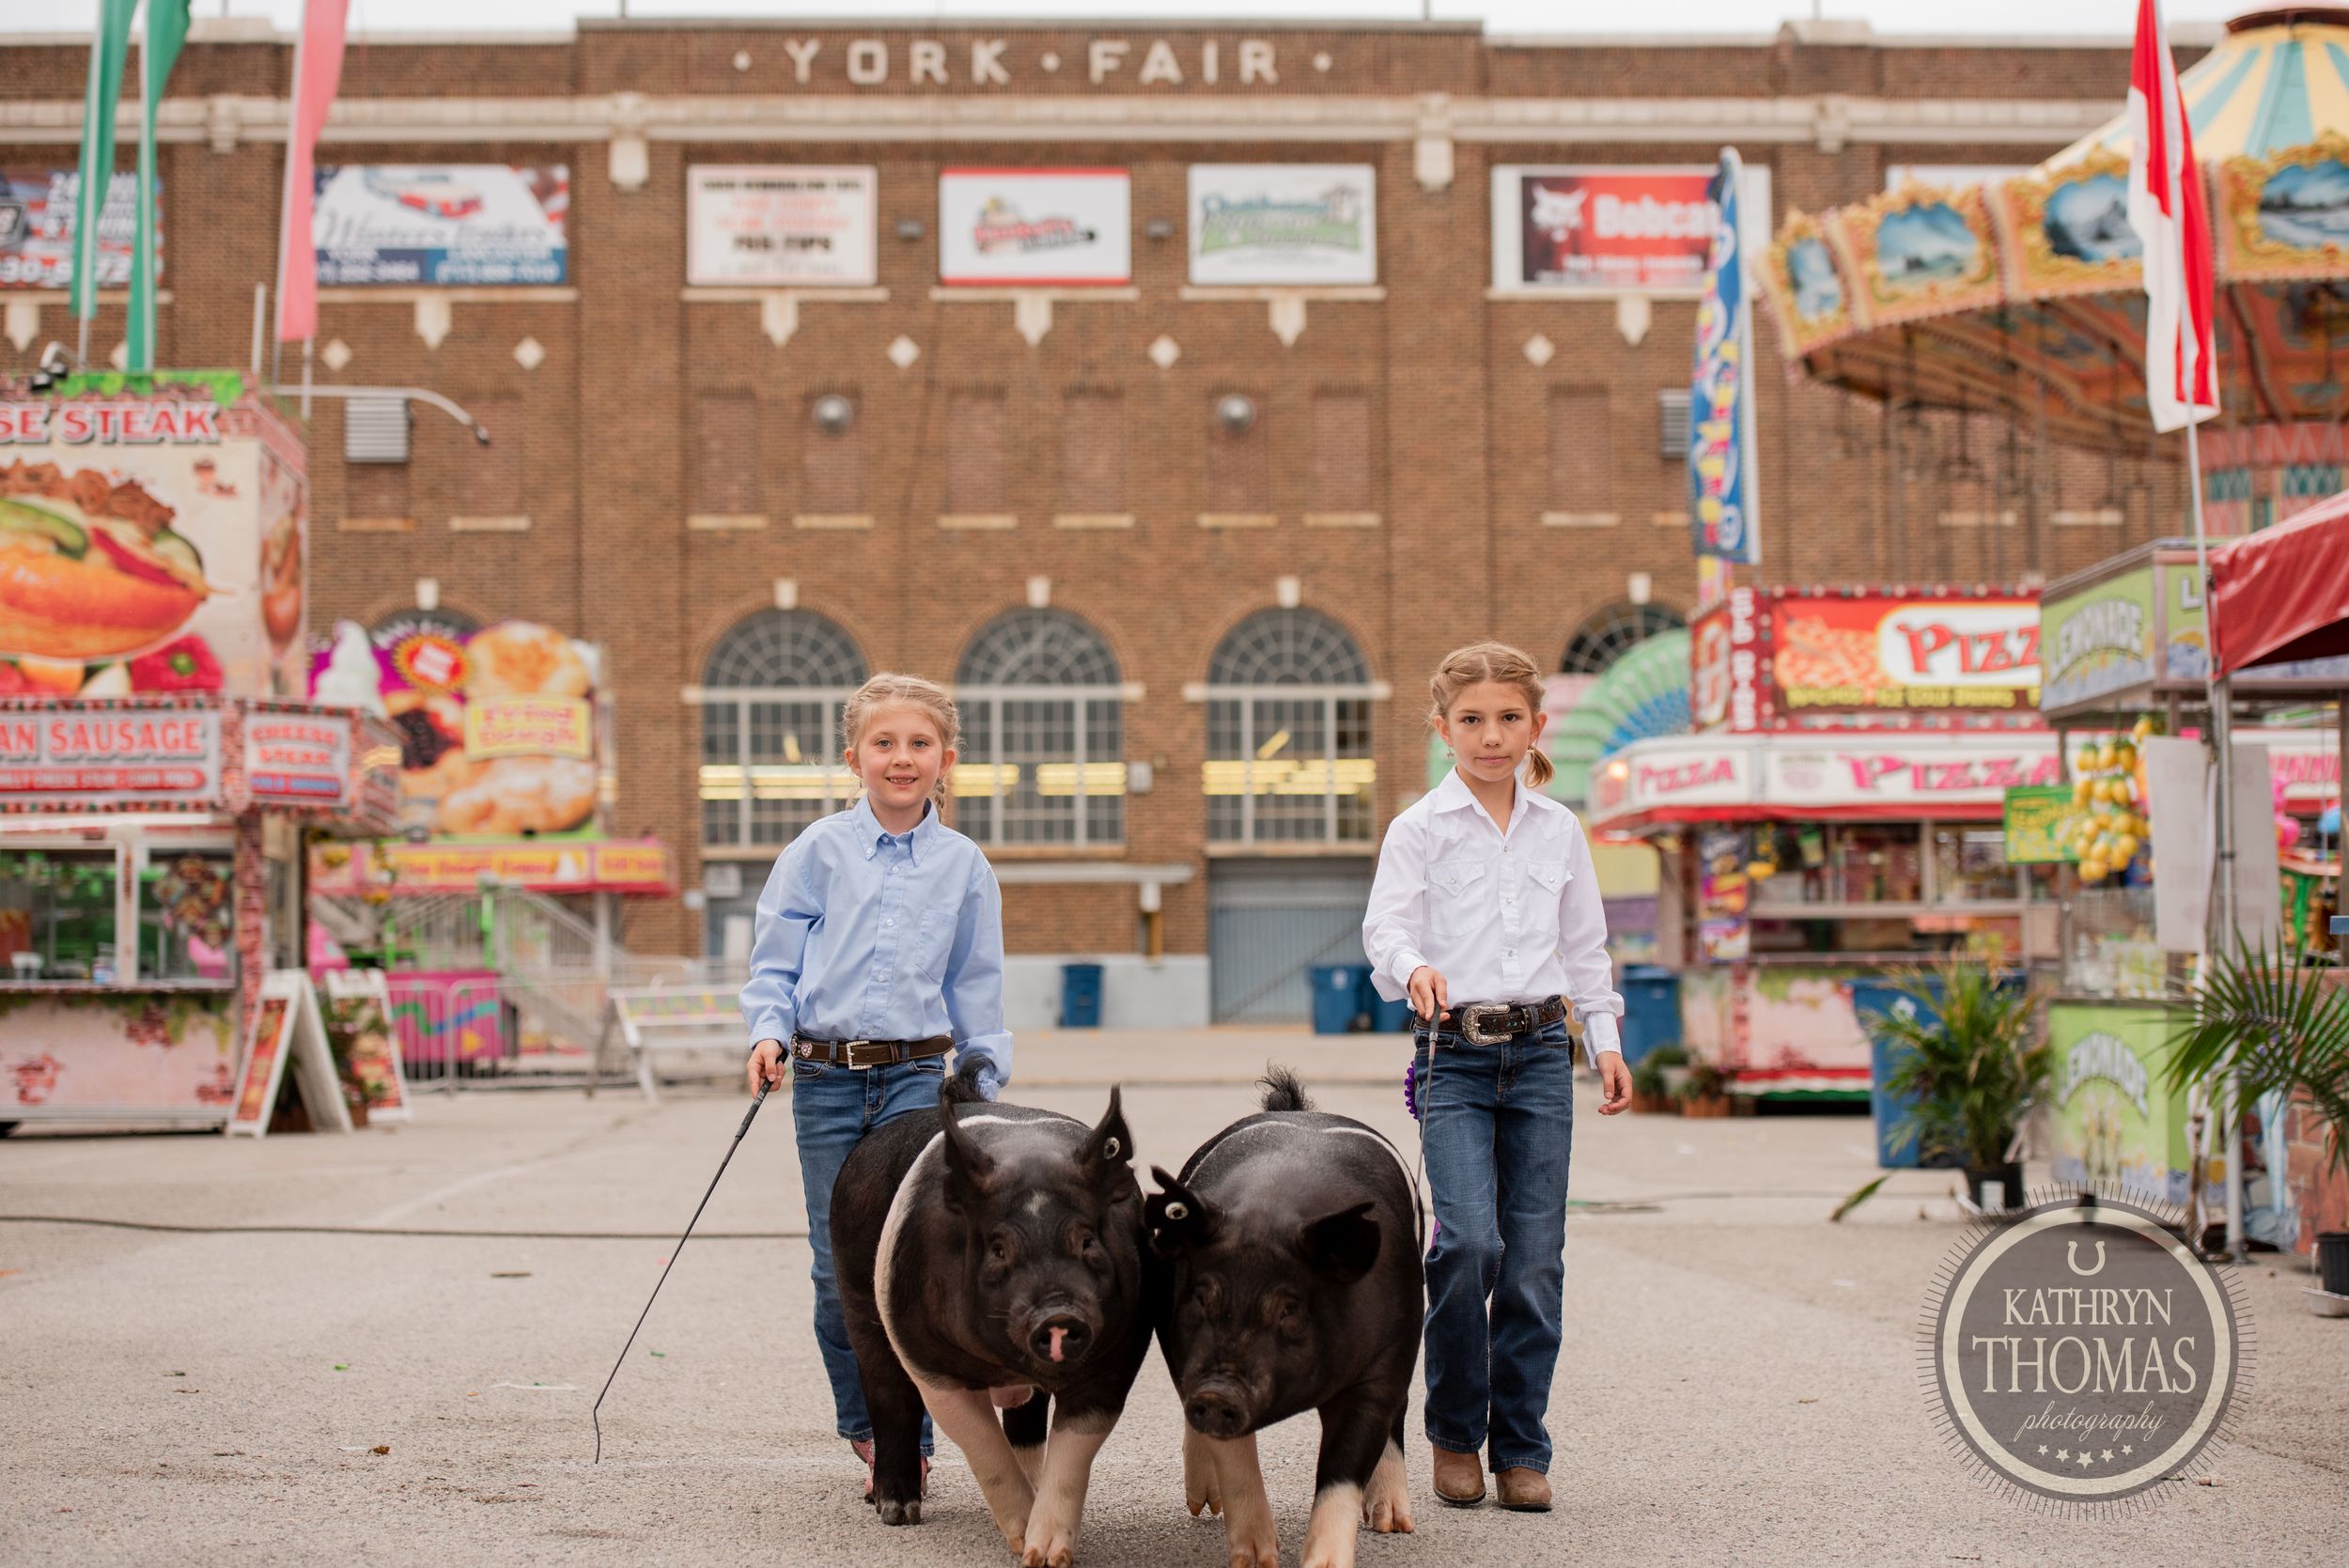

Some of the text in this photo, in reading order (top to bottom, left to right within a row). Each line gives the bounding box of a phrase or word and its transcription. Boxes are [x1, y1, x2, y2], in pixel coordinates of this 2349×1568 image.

[784, 39, 1279, 85] YORK FAIR
[59, 402, 219, 443] STEAK
[1896, 623, 2040, 674] PIZZ
[2047, 598, 2144, 680] LEMONADE
[50, 721, 204, 752] SAUSAGE
[251, 725, 336, 746] CHEESE
[258, 747, 332, 767] STEAK
[1638, 757, 1734, 792] PIZZA
[1838, 753, 2060, 789] PIZZA
